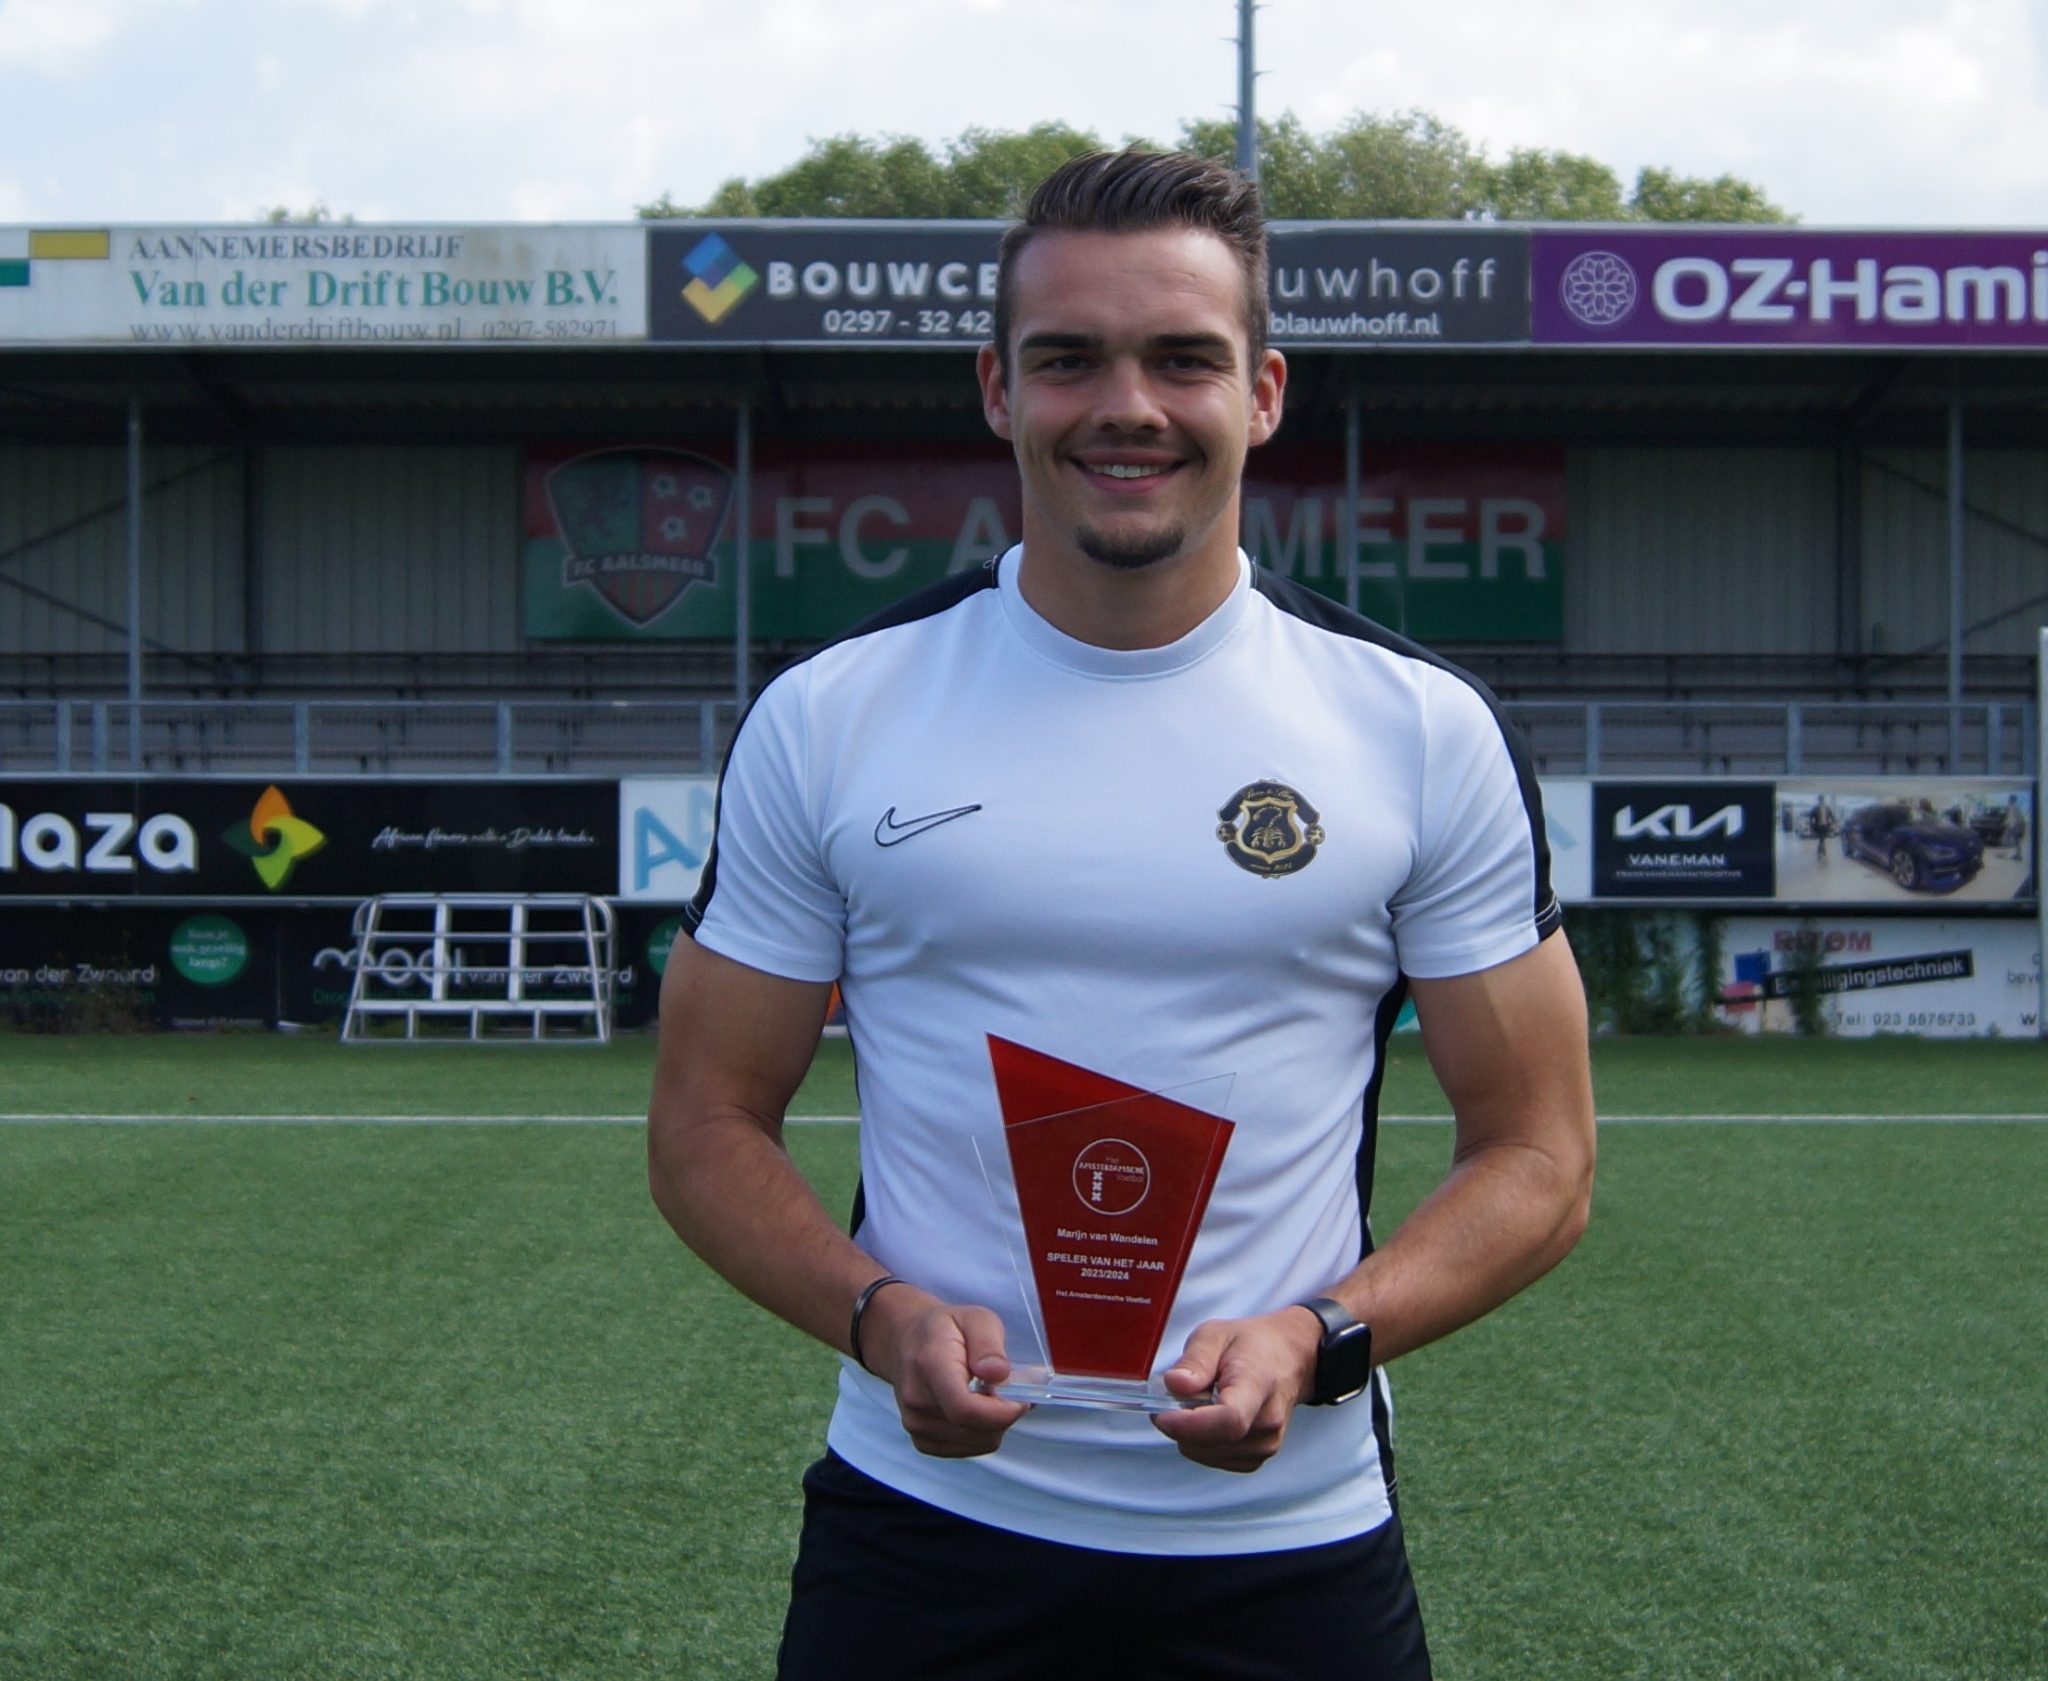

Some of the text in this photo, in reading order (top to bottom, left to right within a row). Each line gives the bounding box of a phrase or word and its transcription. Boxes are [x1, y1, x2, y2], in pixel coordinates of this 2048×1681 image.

[129, 235, 463, 259] AANNEMERSBEDRIJF
[129, 270, 619, 308] Van der Drift Bouw B.V.
[129, 317, 619, 341] www.vanderdriftbouw.nl 0297-582971
[823, 310, 892, 333] 0297
[918, 310, 950, 333] 32
[957, 310, 992, 333] 42
[1270, 312, 1440, 336] blauwhoff.nl
[775, 495, 910, 580] FC
[1628, 853, 1726, 867] VANEMAN
[35, 964, 71, 983] der
[1056, 1228, 1158, 1245] Marijn van Wandelen
[1046, 1252, 1165, 1271] SPELER VAN HET JAAR
[1080, 1268, 1130, 1280] 2023/2024
